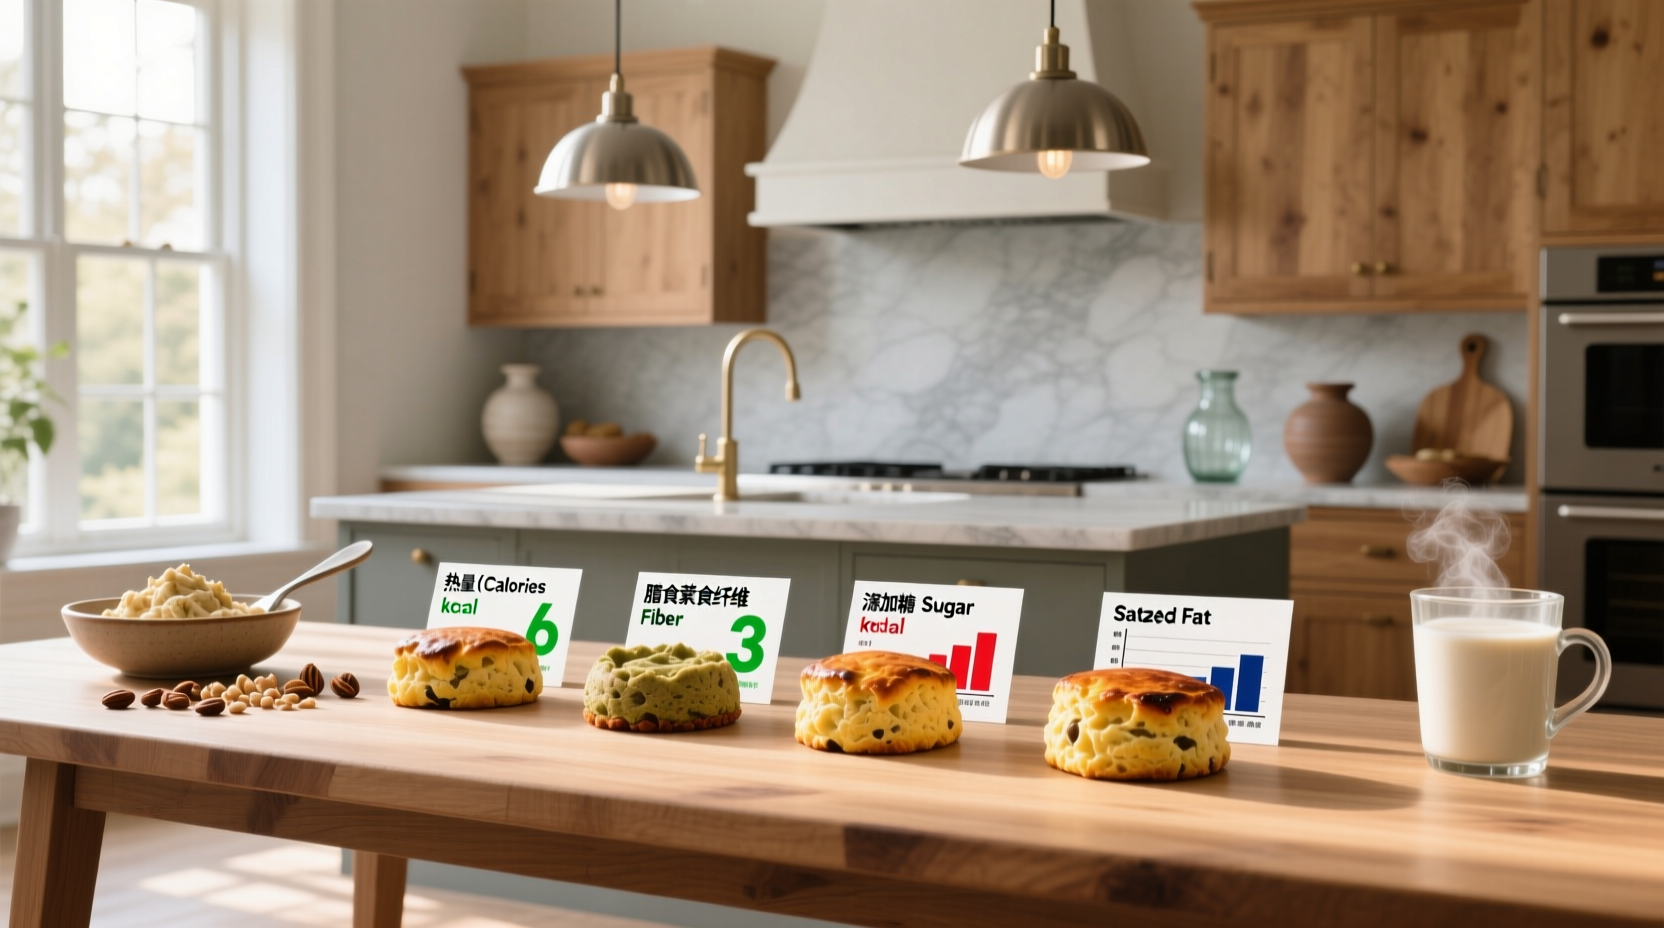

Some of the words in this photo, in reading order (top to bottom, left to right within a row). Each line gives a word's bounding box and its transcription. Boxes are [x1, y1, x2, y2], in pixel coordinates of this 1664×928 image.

[640, 608, 684, 626] Fiber
[921, 596, 975, 618] Sugar
[1182, 607, 1212, 625] Fat
[526, 602, 559, 656] 6
[725, 614, 767, 673] 3
